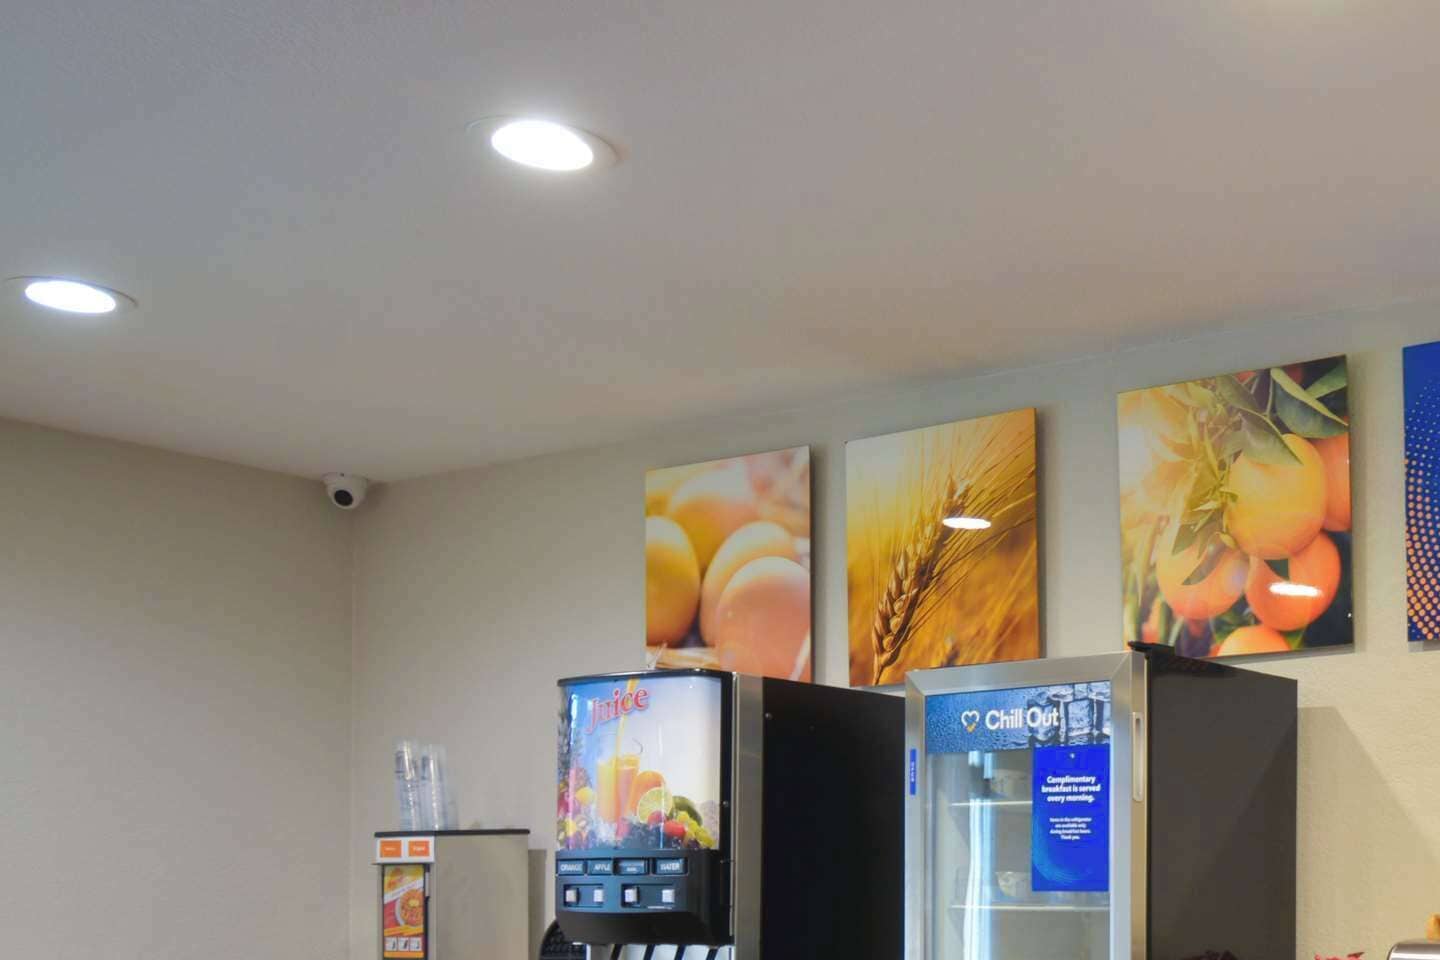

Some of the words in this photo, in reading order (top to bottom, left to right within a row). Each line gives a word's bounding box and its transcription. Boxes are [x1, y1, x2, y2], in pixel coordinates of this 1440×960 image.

[585, 688, 650, 736] Juice
[985, 708, 1024, 730] Chill
[1027, 706, 1060, 728] Out
[1047, 775, 1096, 785] Complimentary
[1041, 784, 1072, 793] breakfast
[1079, 784, 1101, 792] served
[1047, 795, 1065, 803] every
[560, 863, 583, 872] ORANGE
[593, 863, 611, 872] APPLE
[660, 862, 681, 871] WATER
